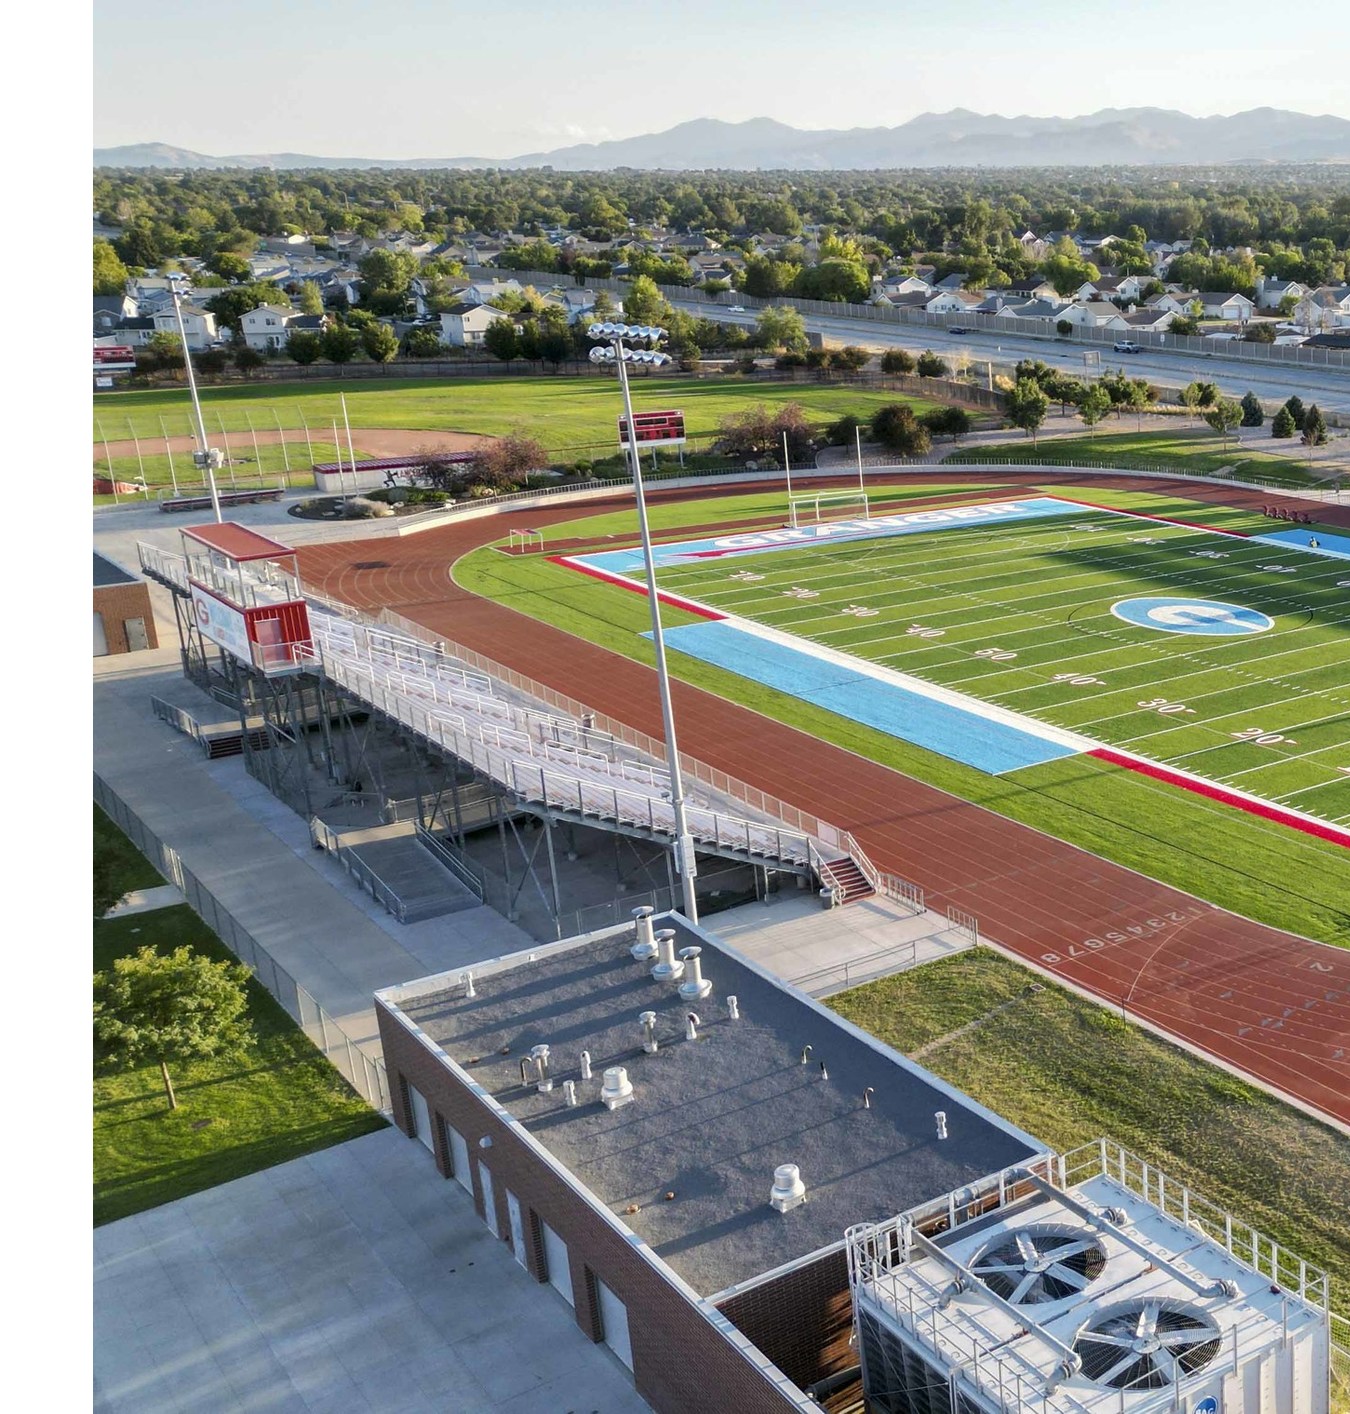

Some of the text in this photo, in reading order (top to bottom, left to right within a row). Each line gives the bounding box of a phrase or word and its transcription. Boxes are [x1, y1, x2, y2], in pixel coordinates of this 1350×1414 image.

[714, 502, 1028, 549] GRANGER
[196, 598, 210, 626] G
[974, 647, 1018, 662] 50
[1053, 672, 1098, 686] 40
[1137, 698, 1186, 714] 30
[1230, 727, 1285, 744] 20
[1165, 912, 1186, 922] 2
[1146, 918, 1166, 928] 3
[1126, 926, 1142, 935] 4
[1106, 932, 1128, 942] 5
[1084, 938, 1104, 949] 6
[1068, 945, 1085, 957] 7
[1040, 953, 1061, 963] 8
[1310, 962, 1334, 972] 2
